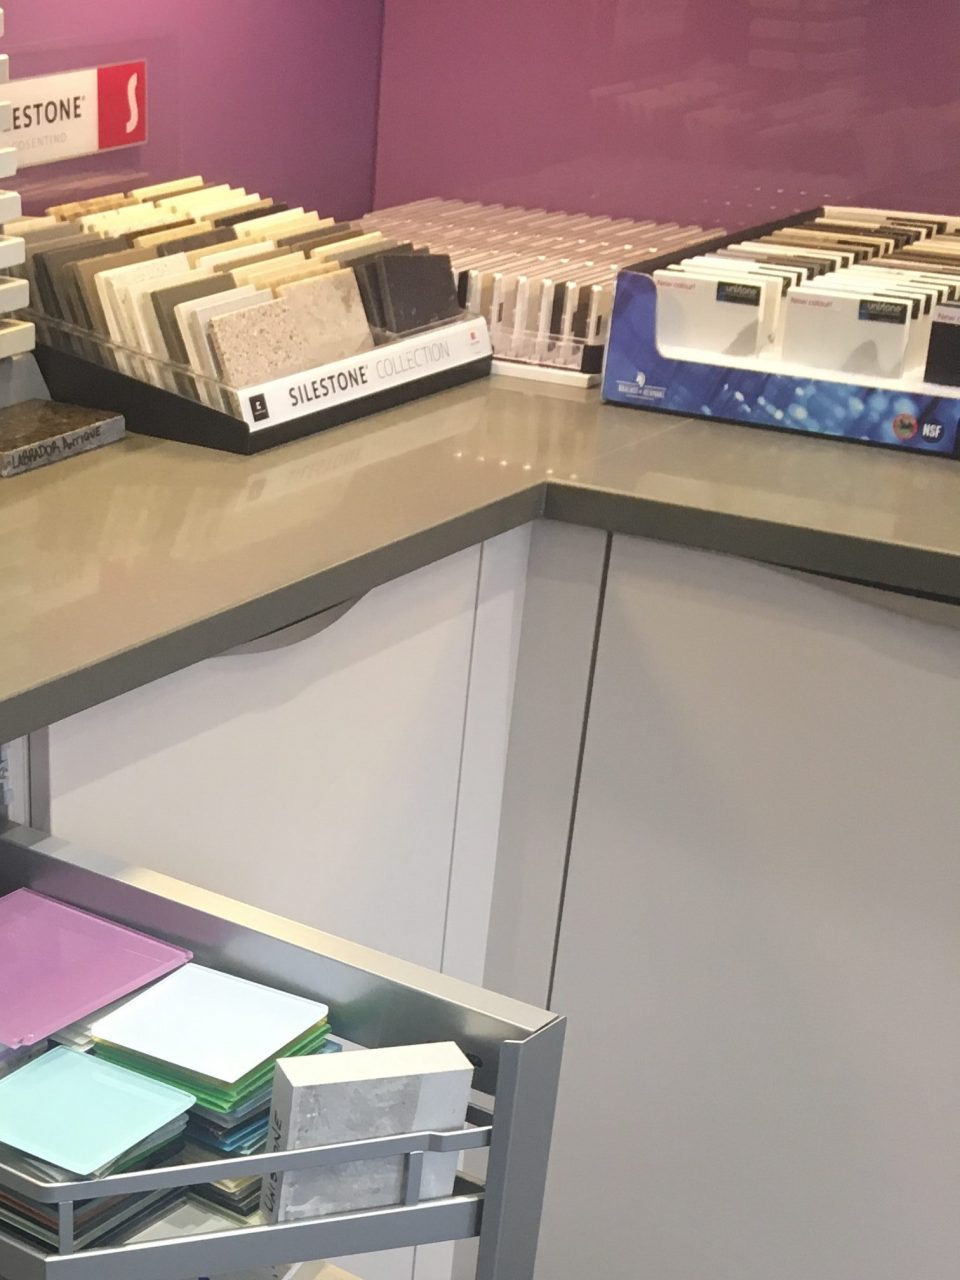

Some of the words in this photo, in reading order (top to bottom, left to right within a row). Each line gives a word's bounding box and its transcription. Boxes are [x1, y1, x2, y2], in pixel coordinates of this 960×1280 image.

[288, 364, 368, 407] SILESTONE
[375, 340, 450, 379] COLLECTION
[922, 423, 942, 438] NSF
